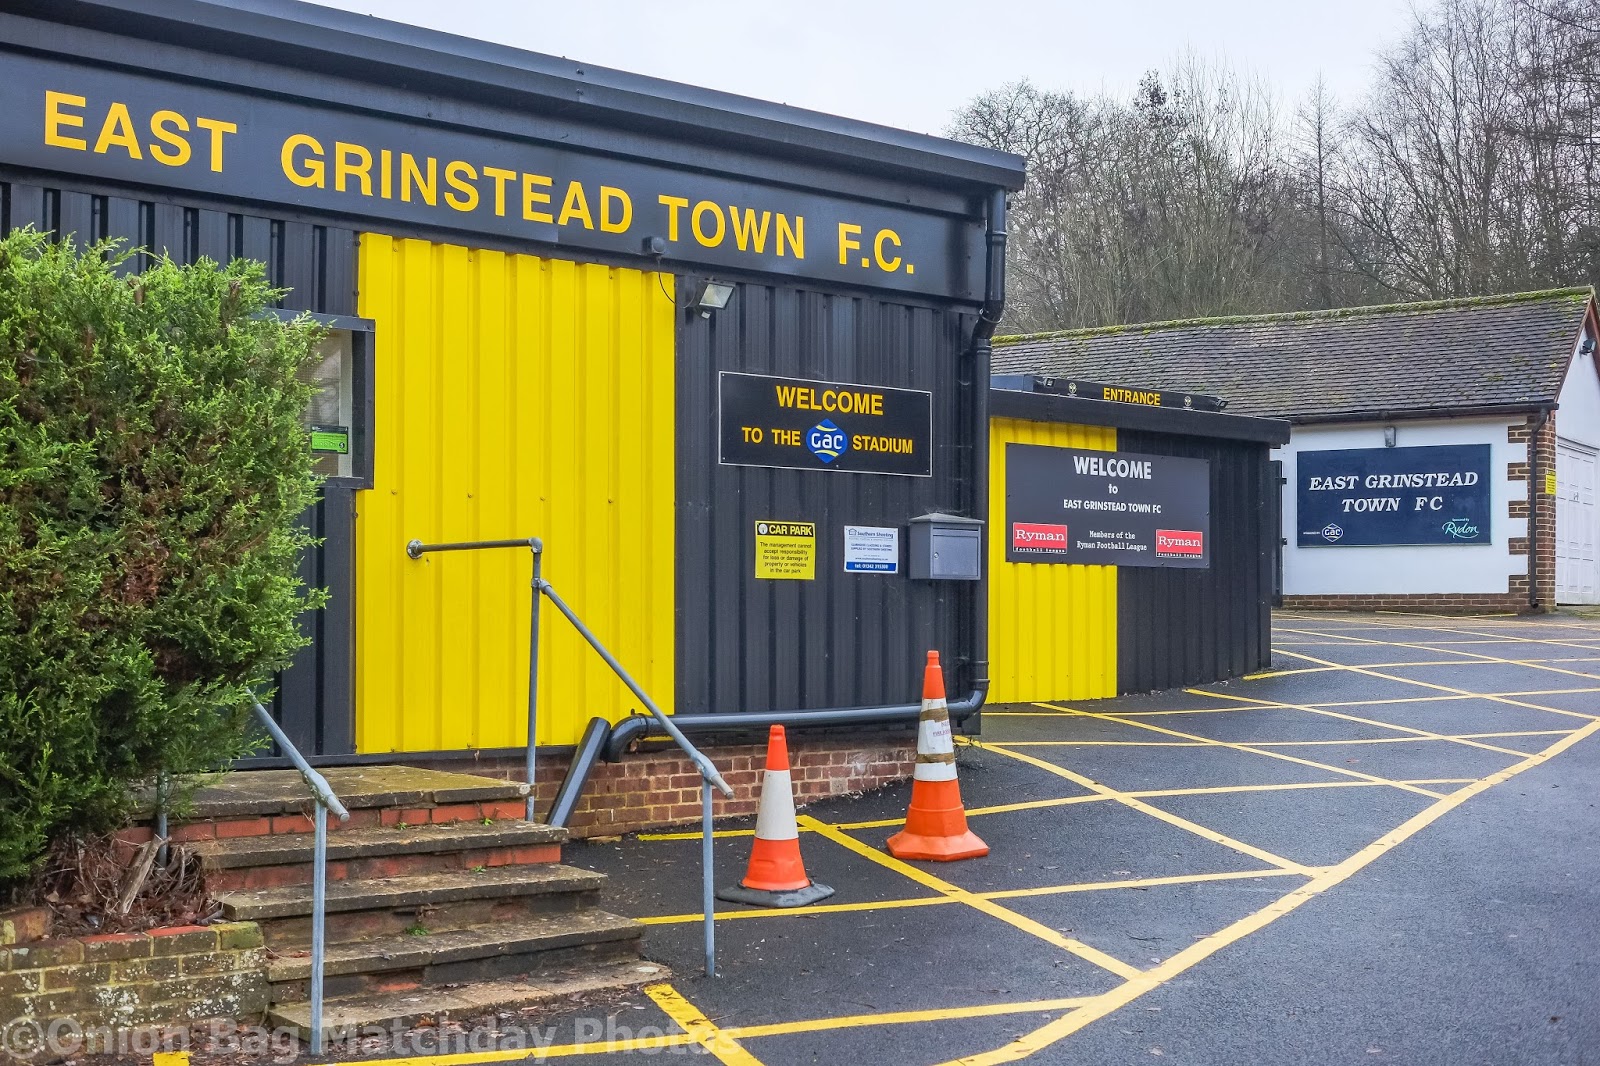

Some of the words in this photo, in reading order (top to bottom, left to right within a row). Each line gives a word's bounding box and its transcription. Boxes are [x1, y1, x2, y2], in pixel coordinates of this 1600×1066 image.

[44, 90, 237, 173] EAST
[281, 134, 633, 234] GRINSTEAD
[658, 194, 805, 260] TOWN
[838, 222, 915, 275] F.C.
[776, 385, 884, 416] WELCOME
[1103, 387, 1161, 406] ENTRANCE
[741, 426, 763, 444] TO
[771, 428, 801, 446] THE
[852, 434, 913, 454] STADIUM
[1073, 455, 1152, 480] WELCOME
[1108, 483, 1118, 494] to
[1308, 475, 1359, 491] EAST
[1364, 471, 1479, 490] GRINSTEAD
[1063, 499, 1082, 509] EAST
[1083, 500, 1127, 512] GRINSTEAD
[1128, 503, 1151, 514] TOWN
[1152, 504, 1162, 514] FC
[1341, 497, 1401, 513] TOWN
[769, 524, 788, 535] CAR
[790, 525, 812, 536] PARK
[1015, 529, 1065, 541] Ryman
[1089, 530, 1115, 539] Members
[1116, 531, 1123, 539] of
[1124, 531, 1136, 539] the
[1441, 521, 1480, 539] Rydon
[1077, 541, 1096, 550] Ryman
[1096, 541, 1125, 550] Football
[1126, 543, 1147, 552] League
[1158, 535, 1201, 547] Ryman
